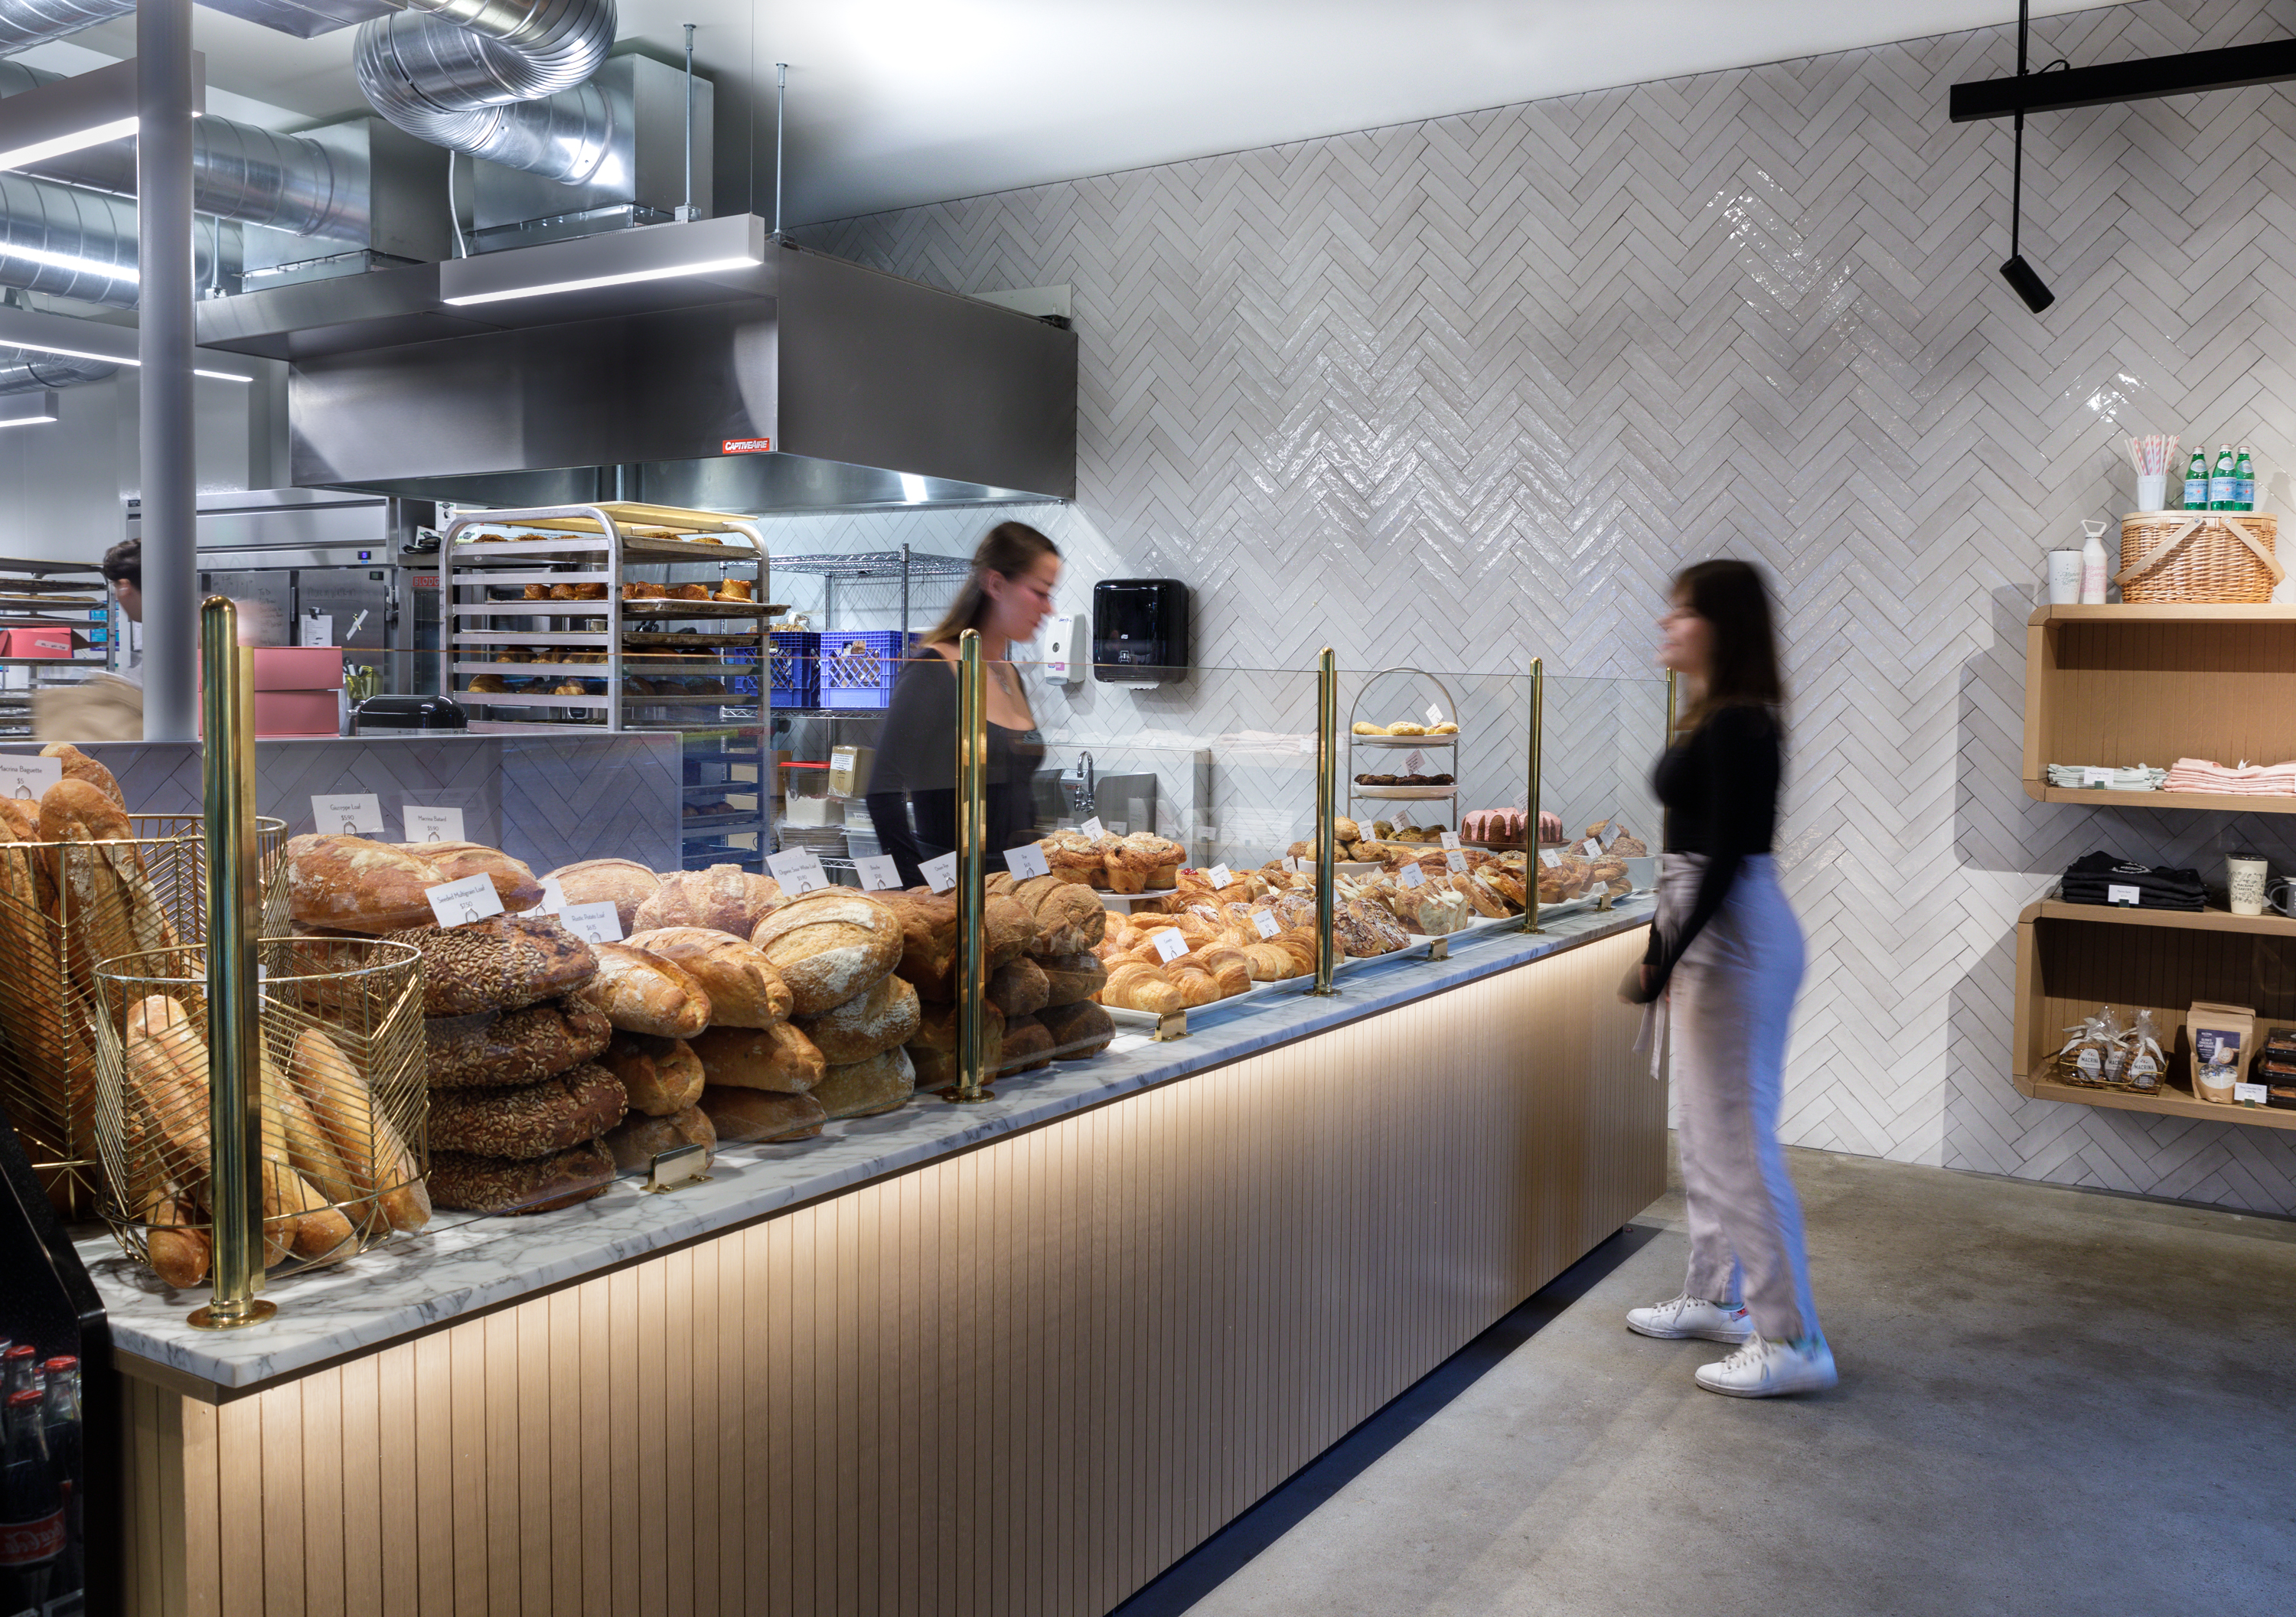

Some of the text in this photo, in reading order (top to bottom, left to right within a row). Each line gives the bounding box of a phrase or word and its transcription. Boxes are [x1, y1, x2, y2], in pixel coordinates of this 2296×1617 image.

[20, 765, 42, 774] Baguette
[437, 884, 485, 904] Seeded Multigrain Loaf
